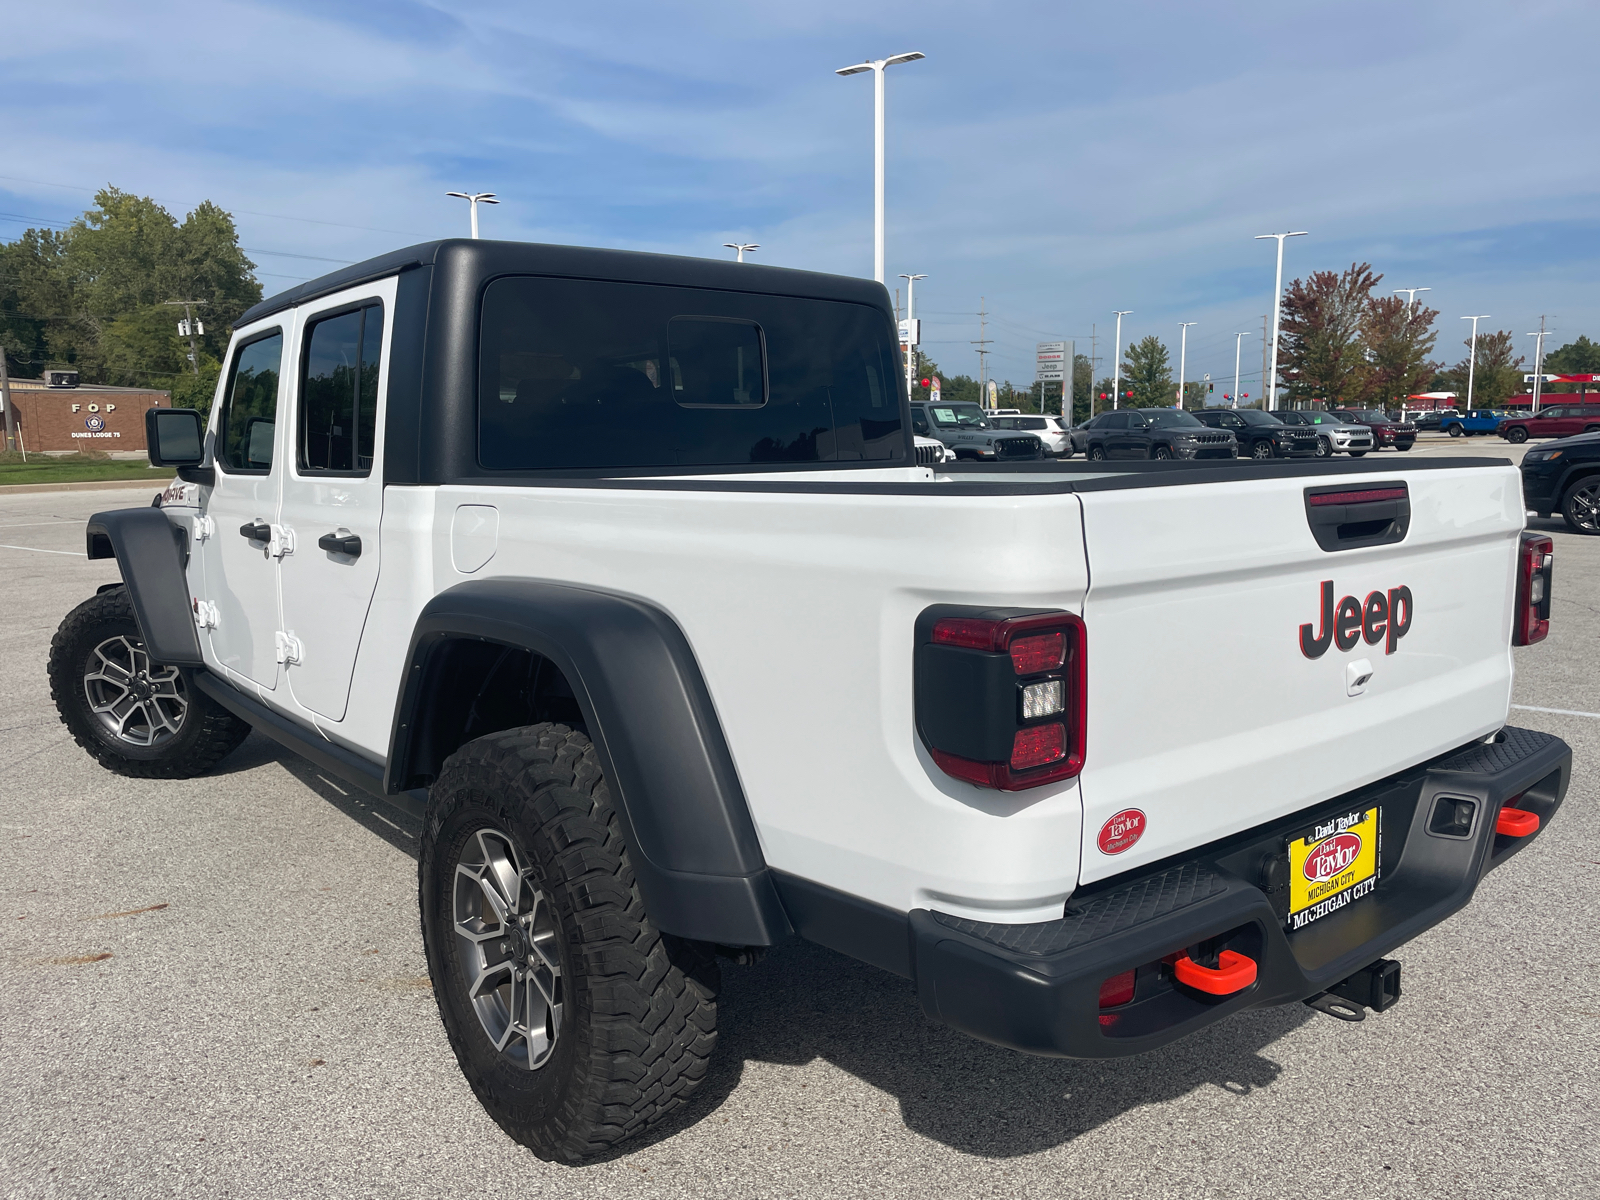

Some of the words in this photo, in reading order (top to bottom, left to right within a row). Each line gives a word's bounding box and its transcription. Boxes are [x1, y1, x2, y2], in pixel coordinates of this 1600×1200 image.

[1041, 363, 1058, 371] Jeep
[1299, 579, 1413, 660] Jeep
[1107, 815, 1141, 839] Taylor
[1314, 819, 1335, 841] David
[1335, 812, 1360, 832] Taylor
[1312, 844, 1356, 880] Taylor
[1319, 838, 1336, 856] David
[1307, 879, 1340, 902] MICHIGAN
[1340, 869, 1356, 887] CITY
[1293, 889, 1352, 930] MICHIGAN
[1353, 875, 1377, 900] CITY
